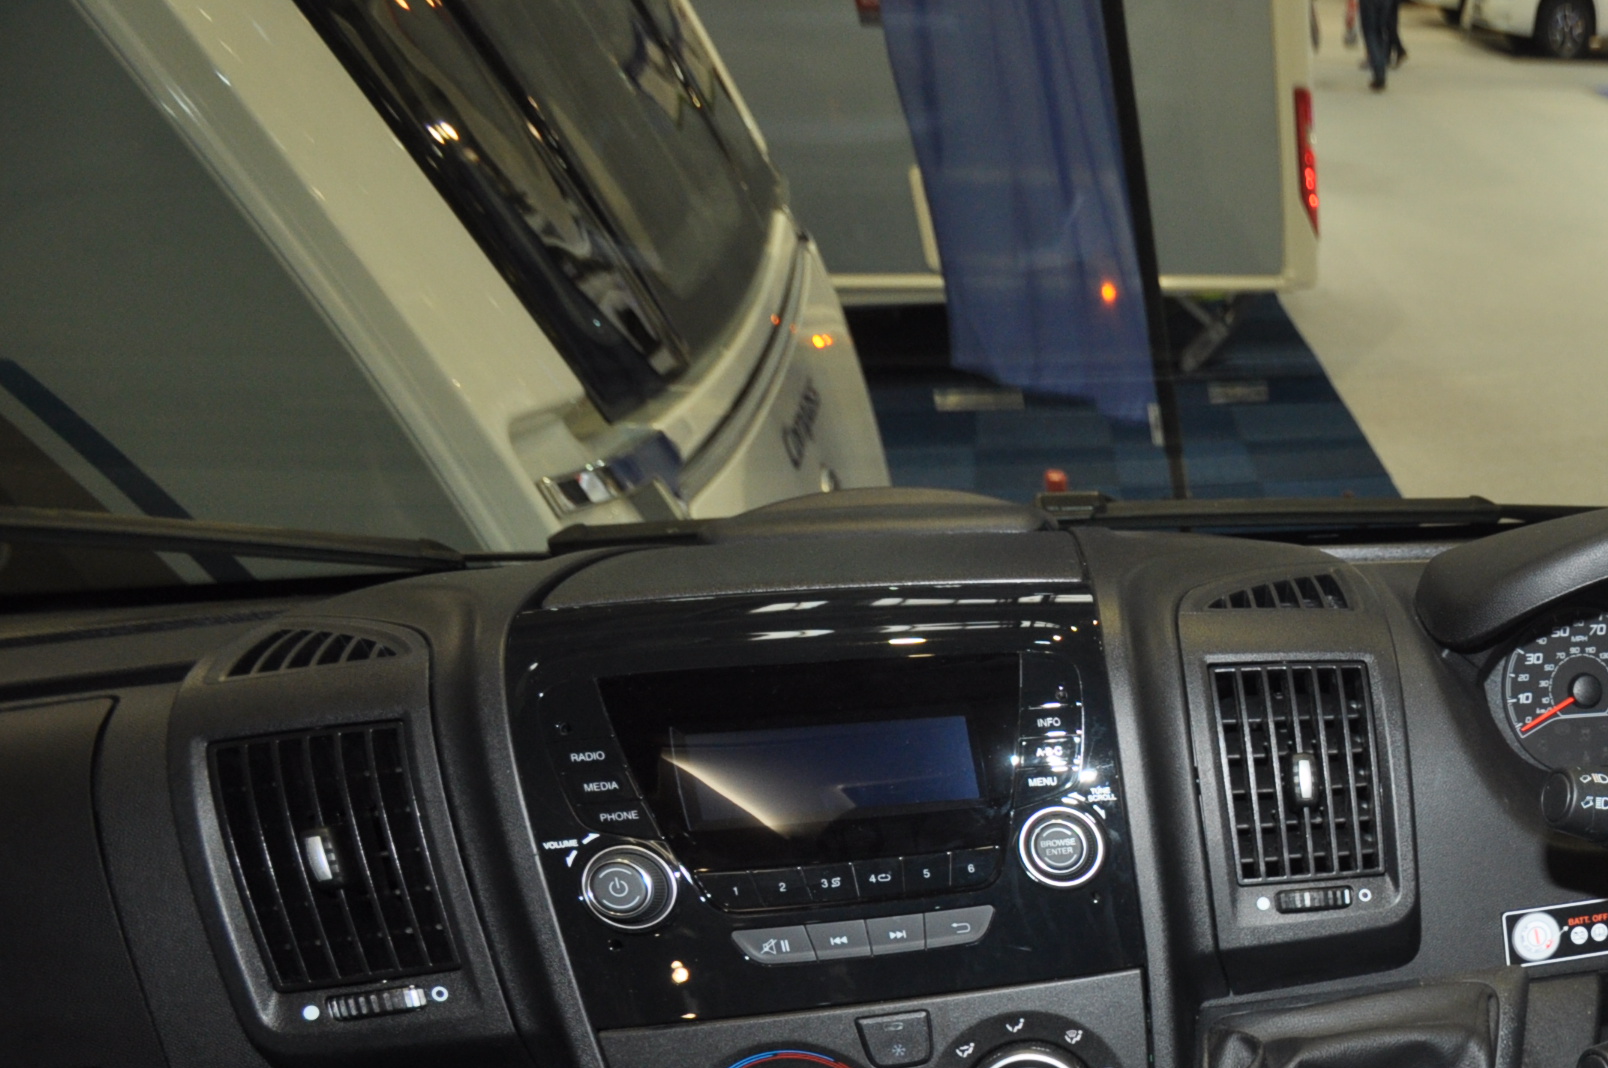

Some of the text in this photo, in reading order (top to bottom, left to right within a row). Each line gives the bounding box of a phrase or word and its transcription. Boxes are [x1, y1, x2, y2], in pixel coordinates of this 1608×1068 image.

[1589, 624, 1606, 636] 70
[1525, 653, 1543, 664] 30
[1518, 692, 1532, 704] 10
[1037, 717, 1061, 727] INFO
[570, 751, 605, 762] RADIO
[583, 781, 619, 792] MEDIA
[1028, 777, 1057, 787] MENU
[1088, 793, 1117, 802] SCROLL
[600, 810, 639, 822] PHONE
[542, 839, 579, 849] VOLUME
[1040, 838, 1076, 848] BROWSE
[1046, 846, 1073, 856] ENTER
[733, 864, 975, 895] 1 2 3 4 5 6
[1567, 913, 1608, 926] BATT. OFF
